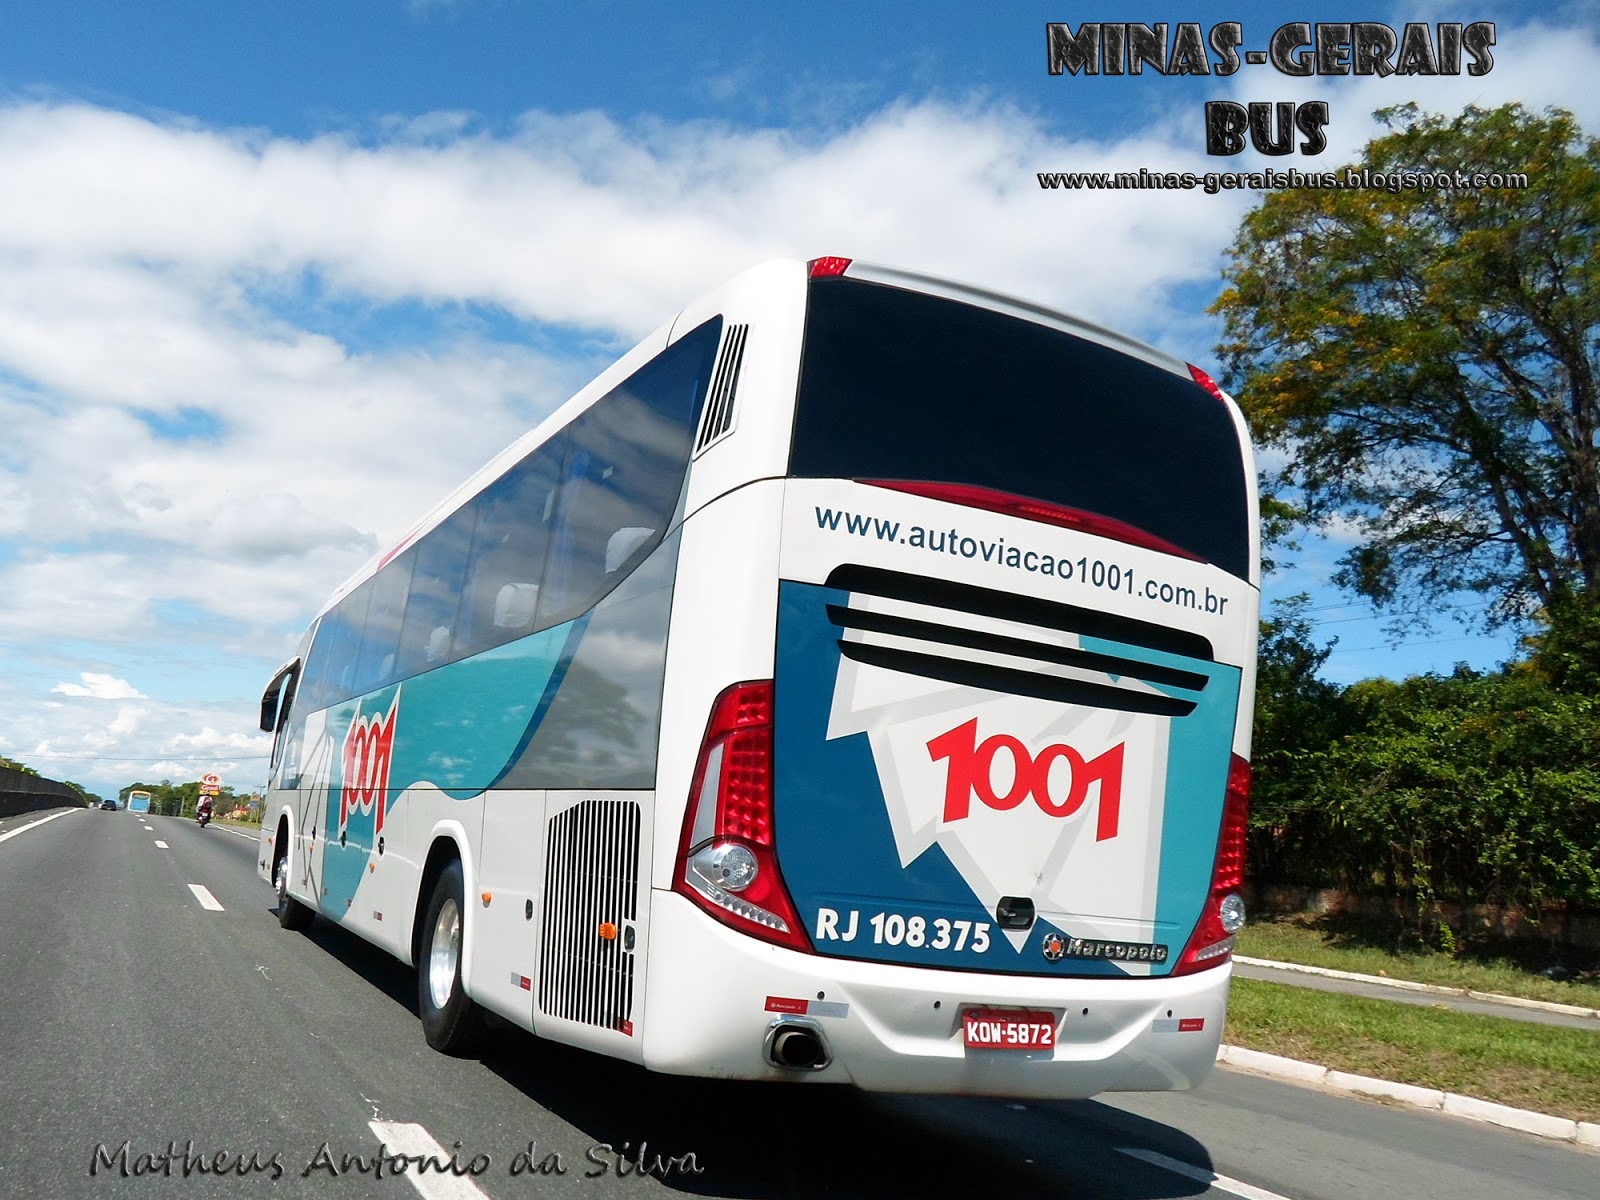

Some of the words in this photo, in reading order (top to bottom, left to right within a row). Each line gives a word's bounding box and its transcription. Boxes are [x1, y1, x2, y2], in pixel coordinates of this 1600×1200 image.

[814, 506, 1229, 616] www.autoviacao1001.com.br
[925, 716, 1126, 843] 1001
[815, 908, 860, 942] RJ
[870, 912, 991, 953] 108.375
[1066, 938, 1168, 961] Marcopolo
